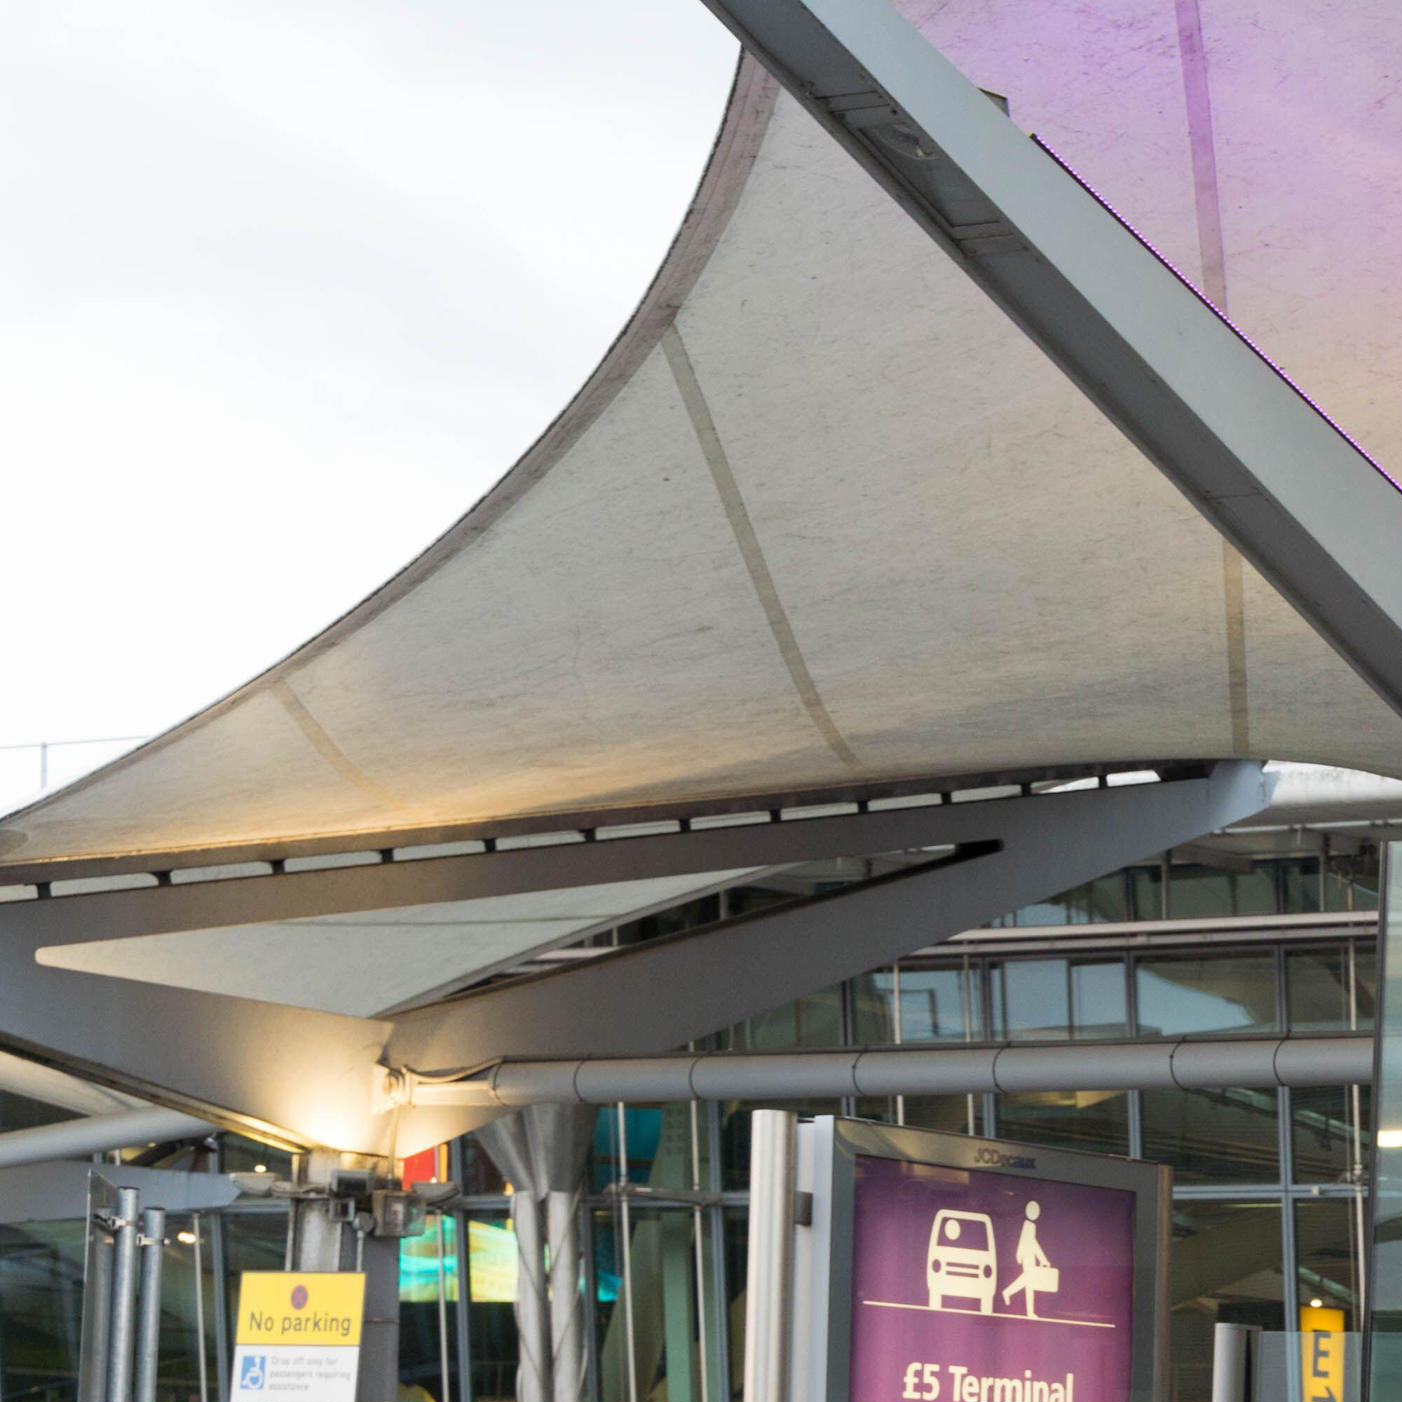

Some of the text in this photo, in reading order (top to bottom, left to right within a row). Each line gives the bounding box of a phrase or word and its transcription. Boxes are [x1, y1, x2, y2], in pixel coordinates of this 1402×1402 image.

[249, 1311, 351, 1337] No parking
[1312, 1329, 1331, 1378] E
[903, 1362, 941, 1401] £5
